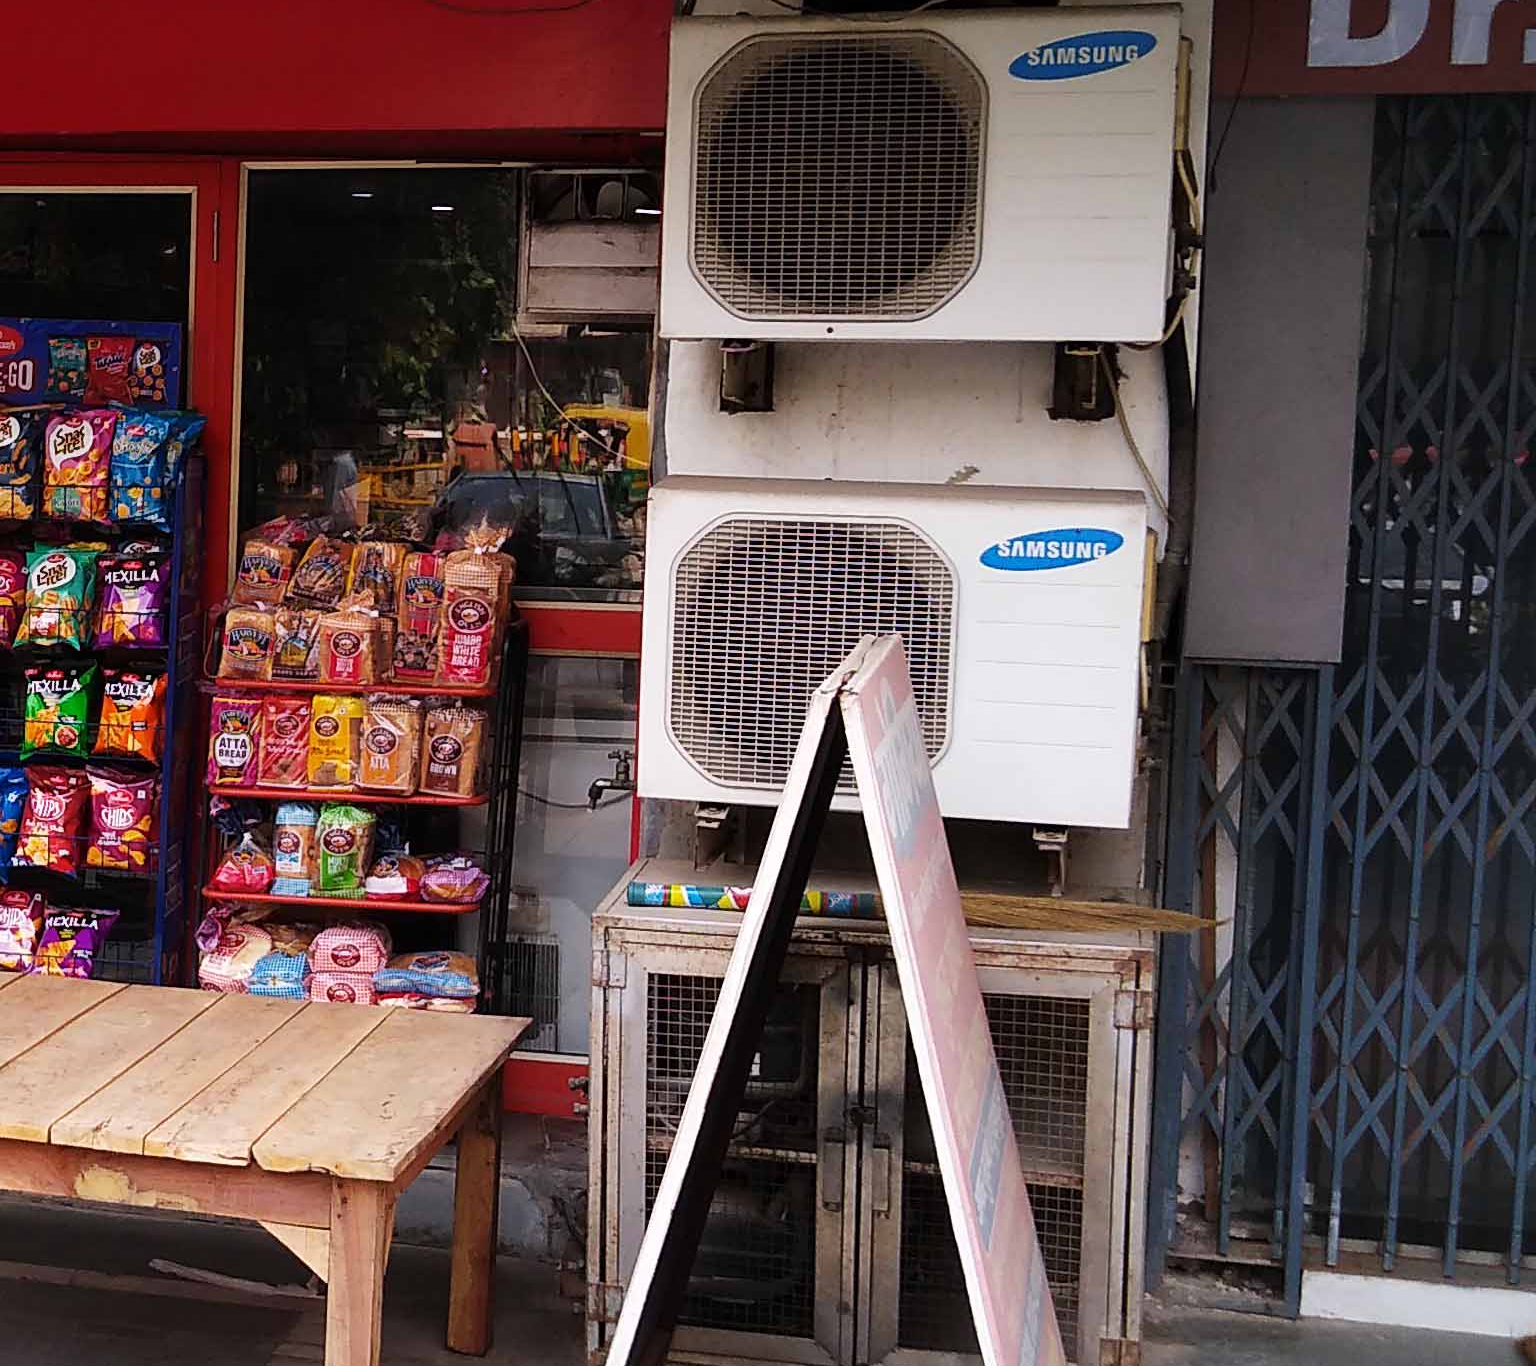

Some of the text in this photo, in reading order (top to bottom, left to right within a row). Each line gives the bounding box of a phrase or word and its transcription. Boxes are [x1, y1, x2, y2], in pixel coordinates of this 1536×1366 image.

[1027, 45, 1138, 66] SAMSUNG
[997, 540, 1107, 558] SAMSUNG
[219, 737, 248, 749] ATTA
[219, 748, 247, 759] BREAD
[101, 807, 135, 828] CHIPS
